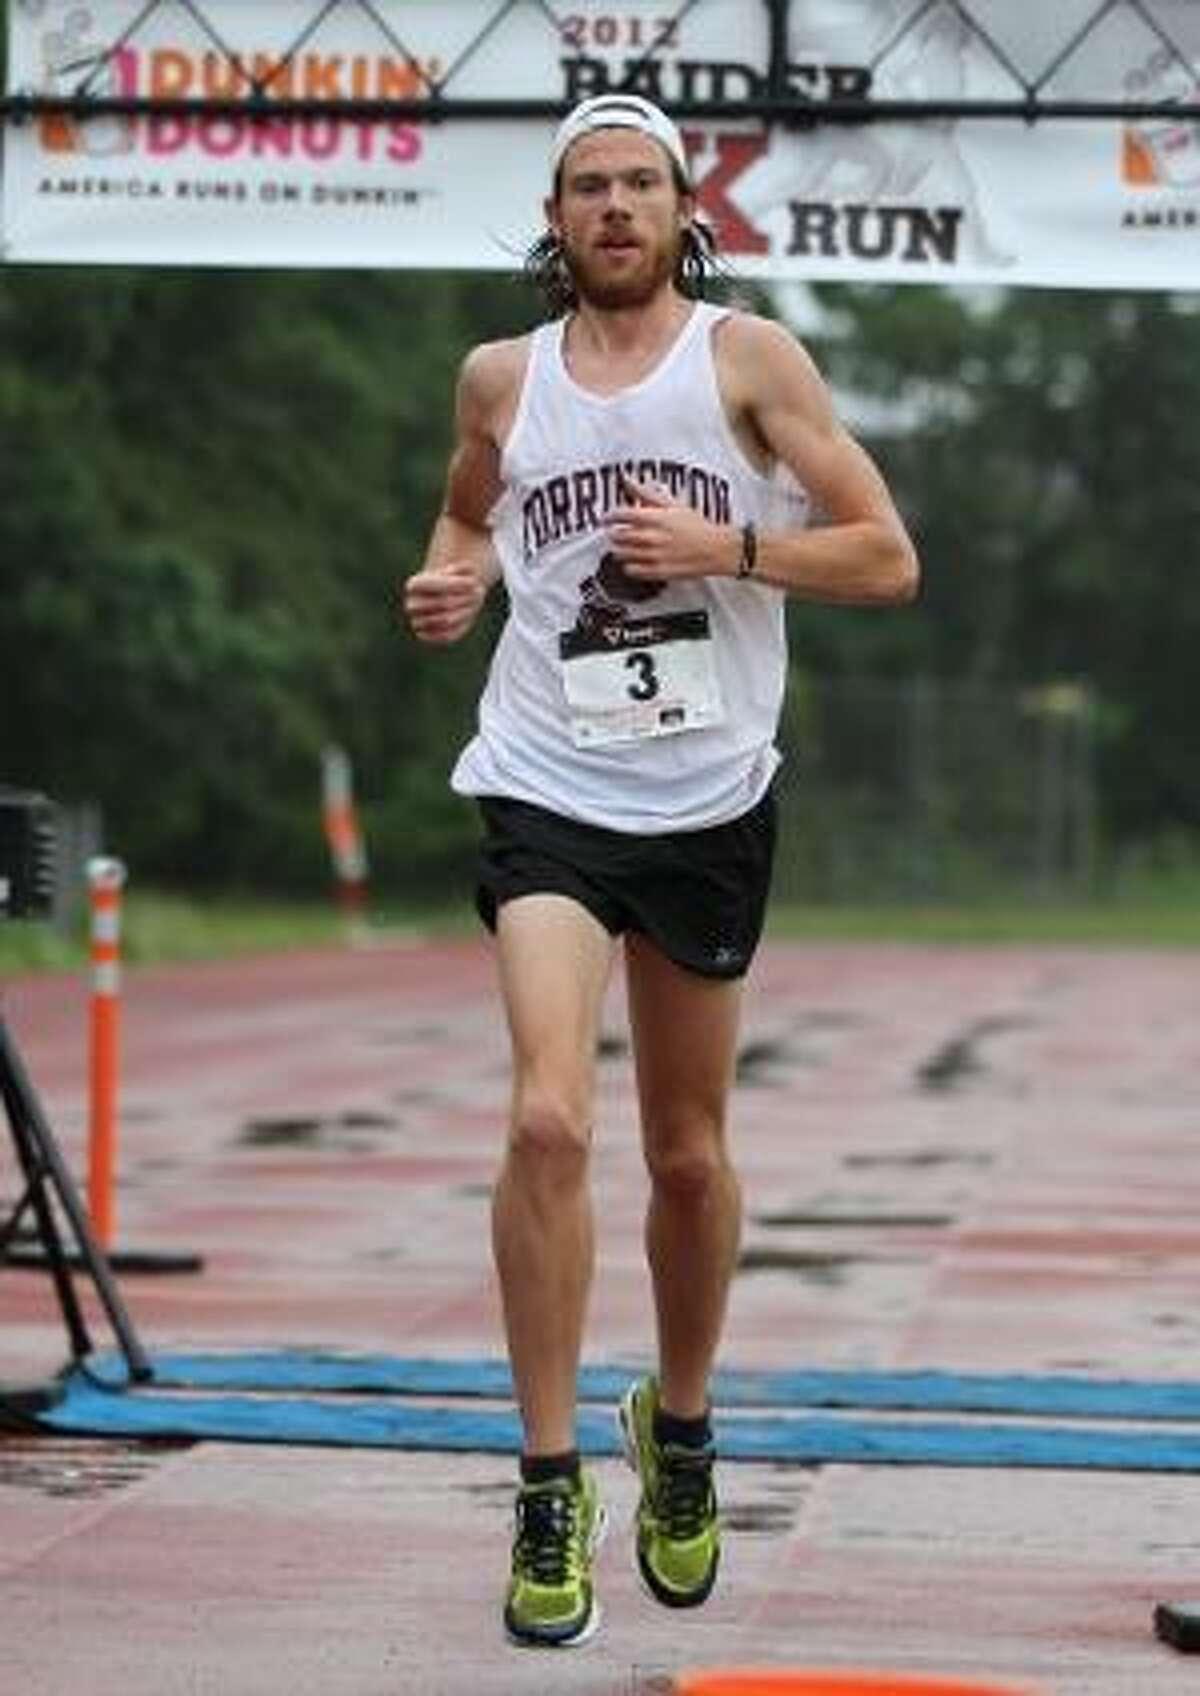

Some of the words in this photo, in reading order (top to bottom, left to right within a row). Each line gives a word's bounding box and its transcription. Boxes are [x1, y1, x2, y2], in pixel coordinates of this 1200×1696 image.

[561, 15, 679, 48] 2012
[561, 57, 872, 104] RAIDER
[145, 112, 421, 162] DONUTS
[39, 178, 161, 197] AMERICA
[176, 180, 247, 200] RUNS
[259, 182, 300, 202] ON
[787, 202, 961, 263] RUN
[624, 651, 660, 702] 3
